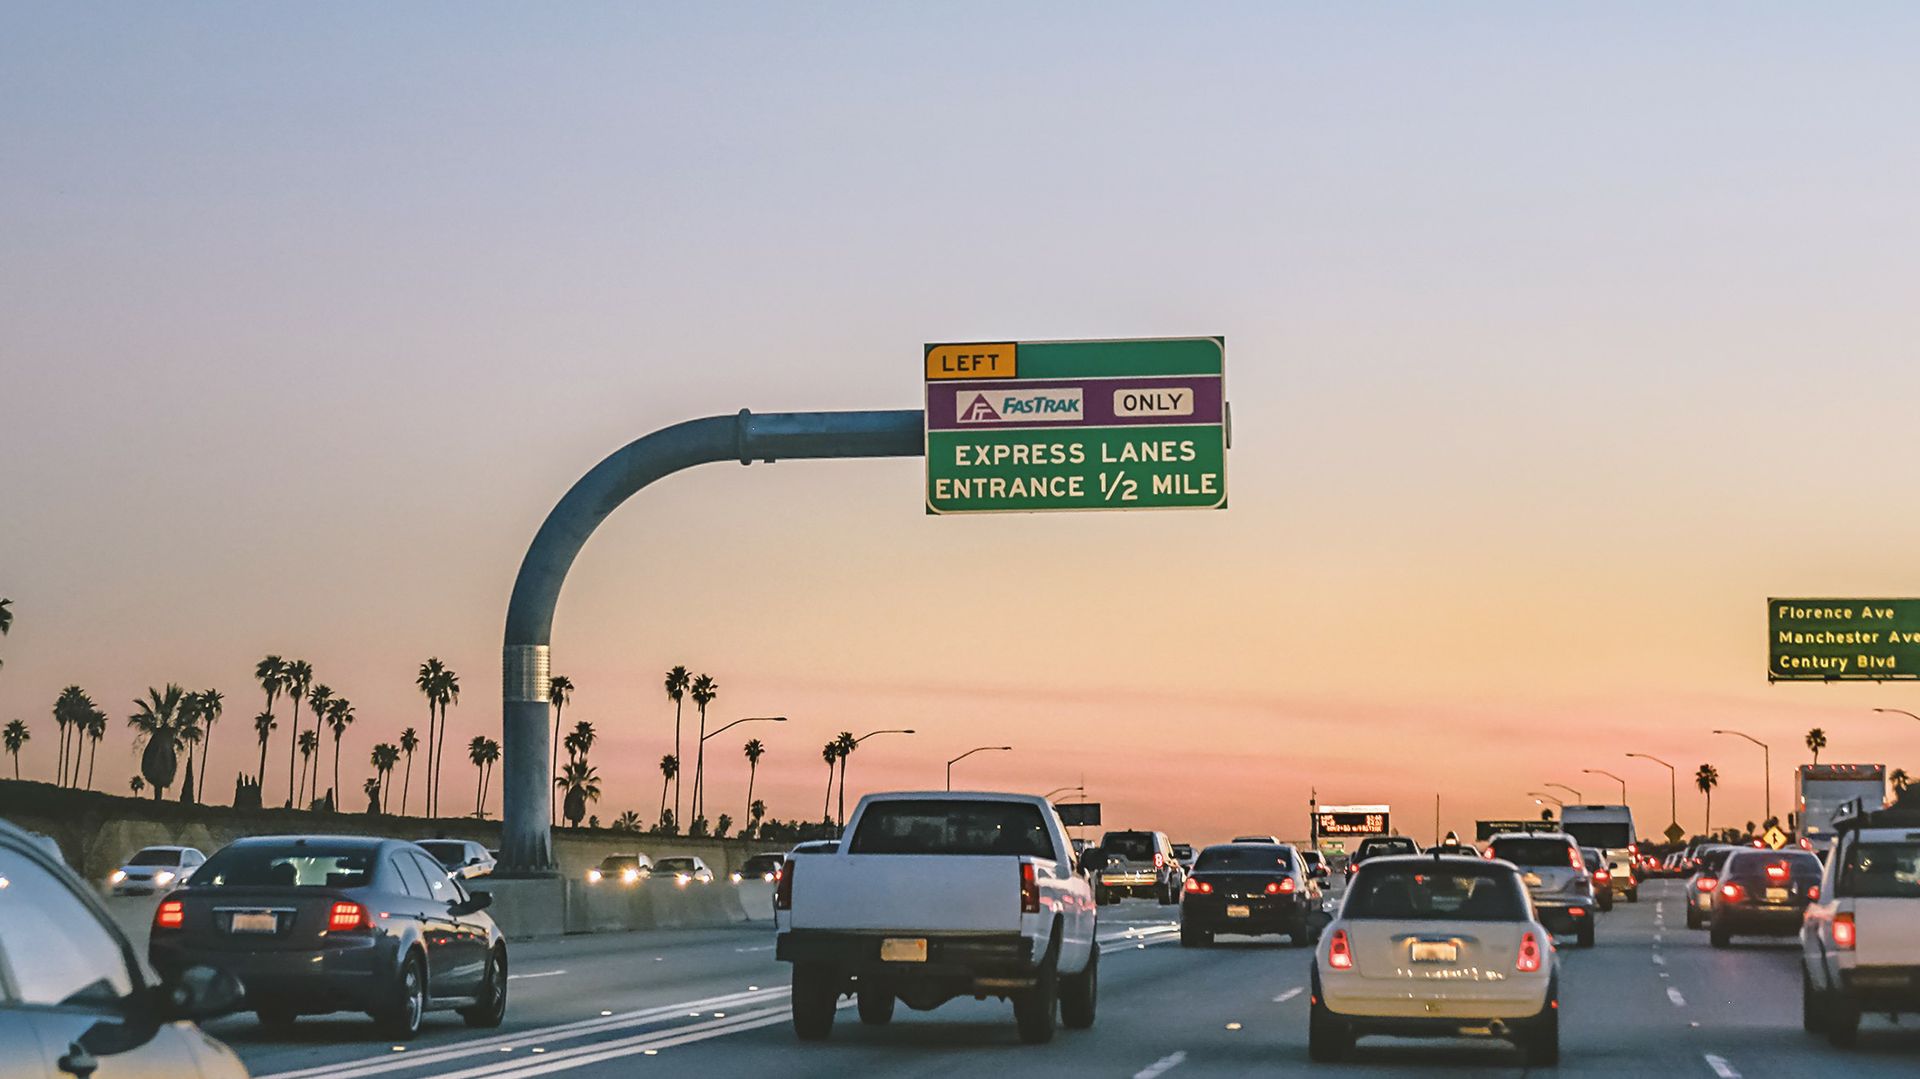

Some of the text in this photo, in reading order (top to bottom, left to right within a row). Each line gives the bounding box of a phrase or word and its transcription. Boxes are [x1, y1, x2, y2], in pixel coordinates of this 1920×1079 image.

[942, 354, 999, 372] LEFT
[1123, 393, 1183, 411] ONLY
[955, 441, 1197, 466] EXPRESS LANES
[935, 476, 1085, 500] ENTRANCE
[1152, 473, 1217, 495] MILE
[1779, 606, 1895, 619] Florence Ave
[1779, 631, 1920, 644] Manchester Ave
[1780, 655, 1896, 672] Century Blvd
